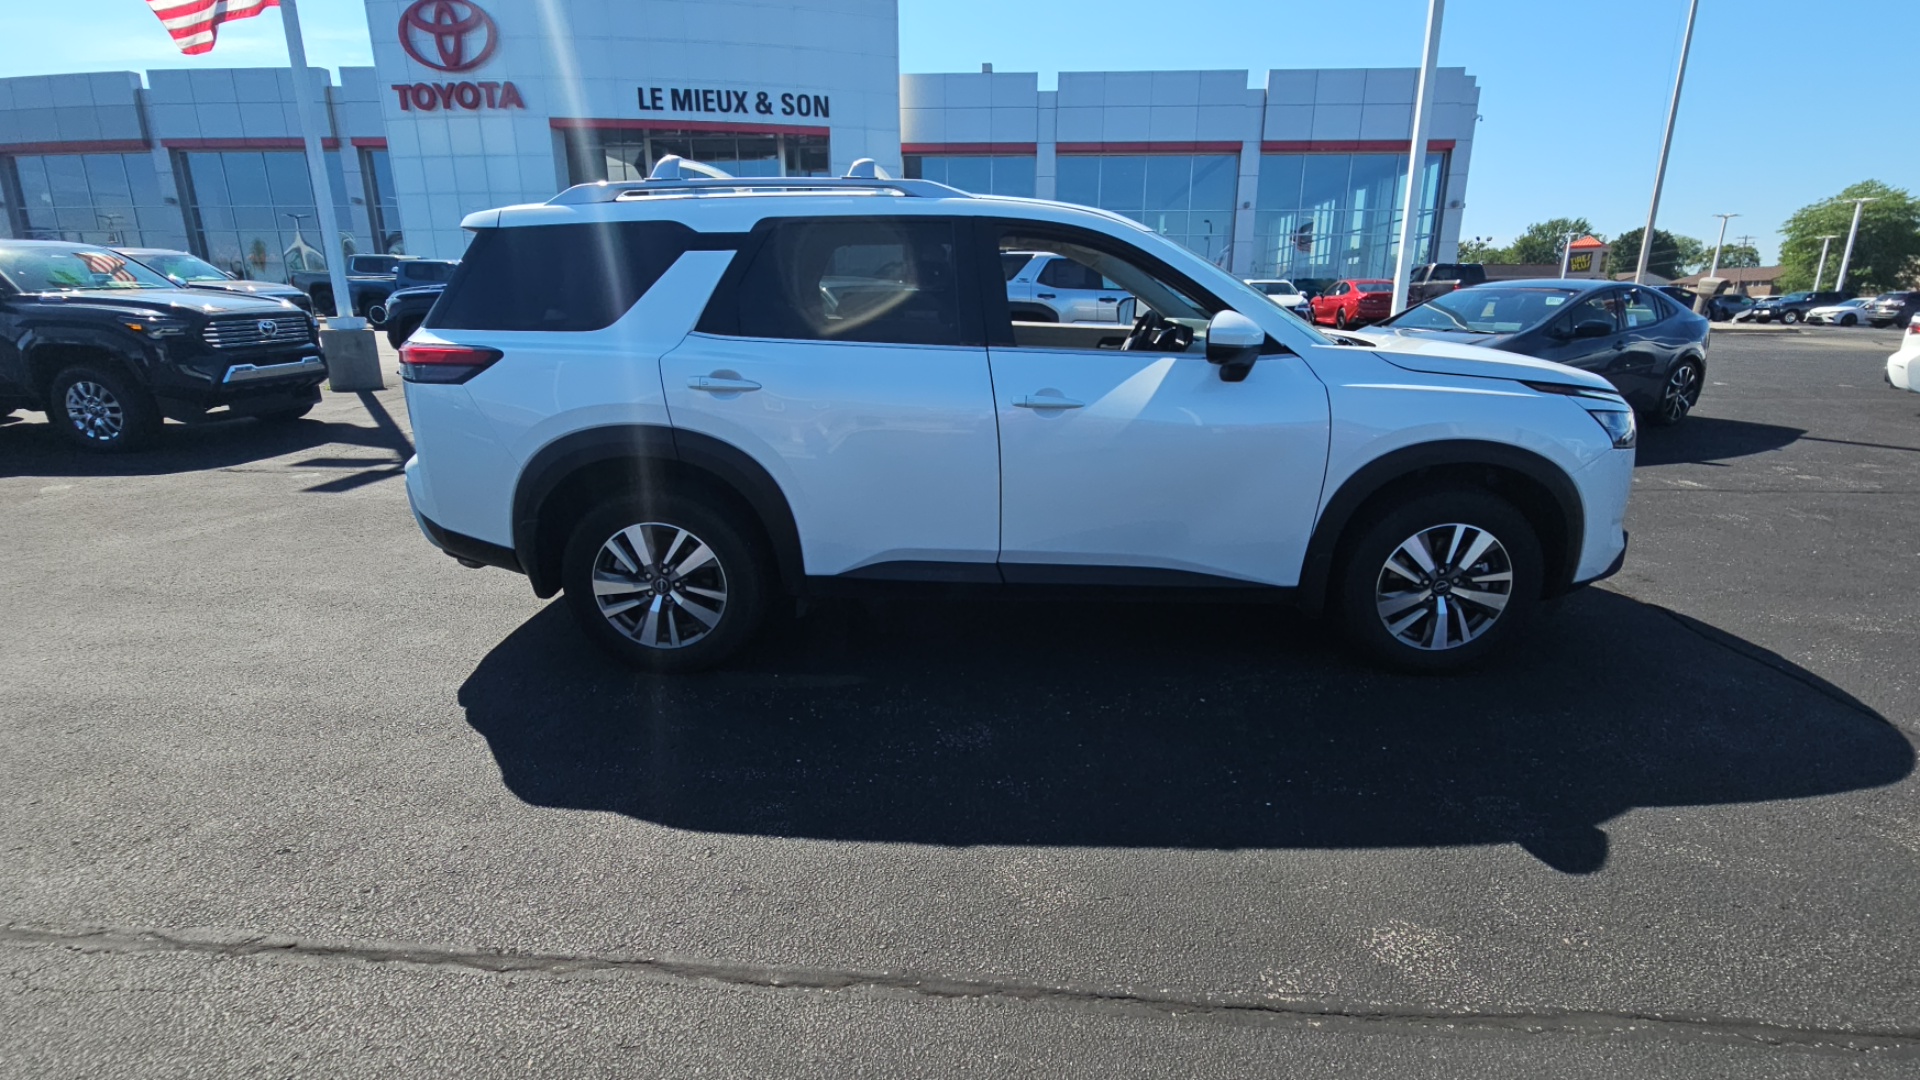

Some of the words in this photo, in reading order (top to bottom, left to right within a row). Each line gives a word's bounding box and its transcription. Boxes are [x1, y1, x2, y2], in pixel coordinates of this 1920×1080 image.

[391, 81, 526, 111] TOYOTA
[637, 87, 664, 110] LE
[670, 88, 749, 114] MIEUX
[755, 91, 774, 115] &
[781, 93, 830, 118] SON
[1572, 261, 1590, 271] PLUS
